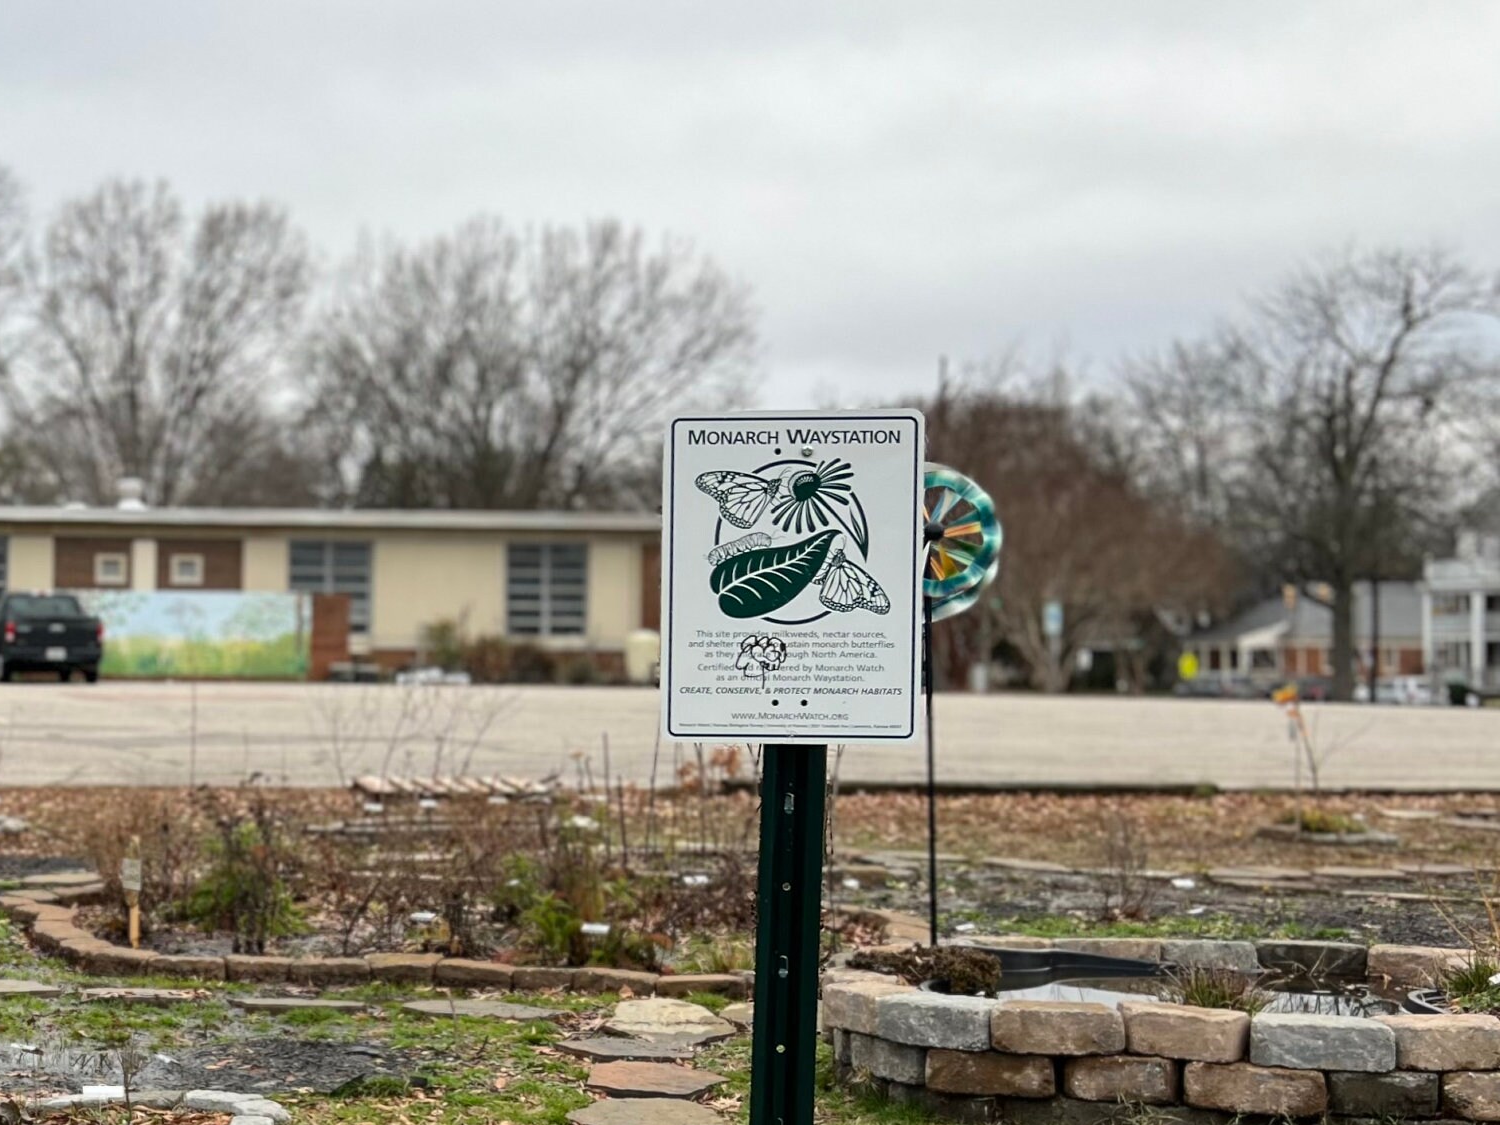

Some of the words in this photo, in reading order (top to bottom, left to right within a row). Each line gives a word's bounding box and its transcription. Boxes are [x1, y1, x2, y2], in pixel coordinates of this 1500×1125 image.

[716, 651, 734, 659] they
[802, 665, 812, 673] by
[861, 687, 902, 695] HABITATS
